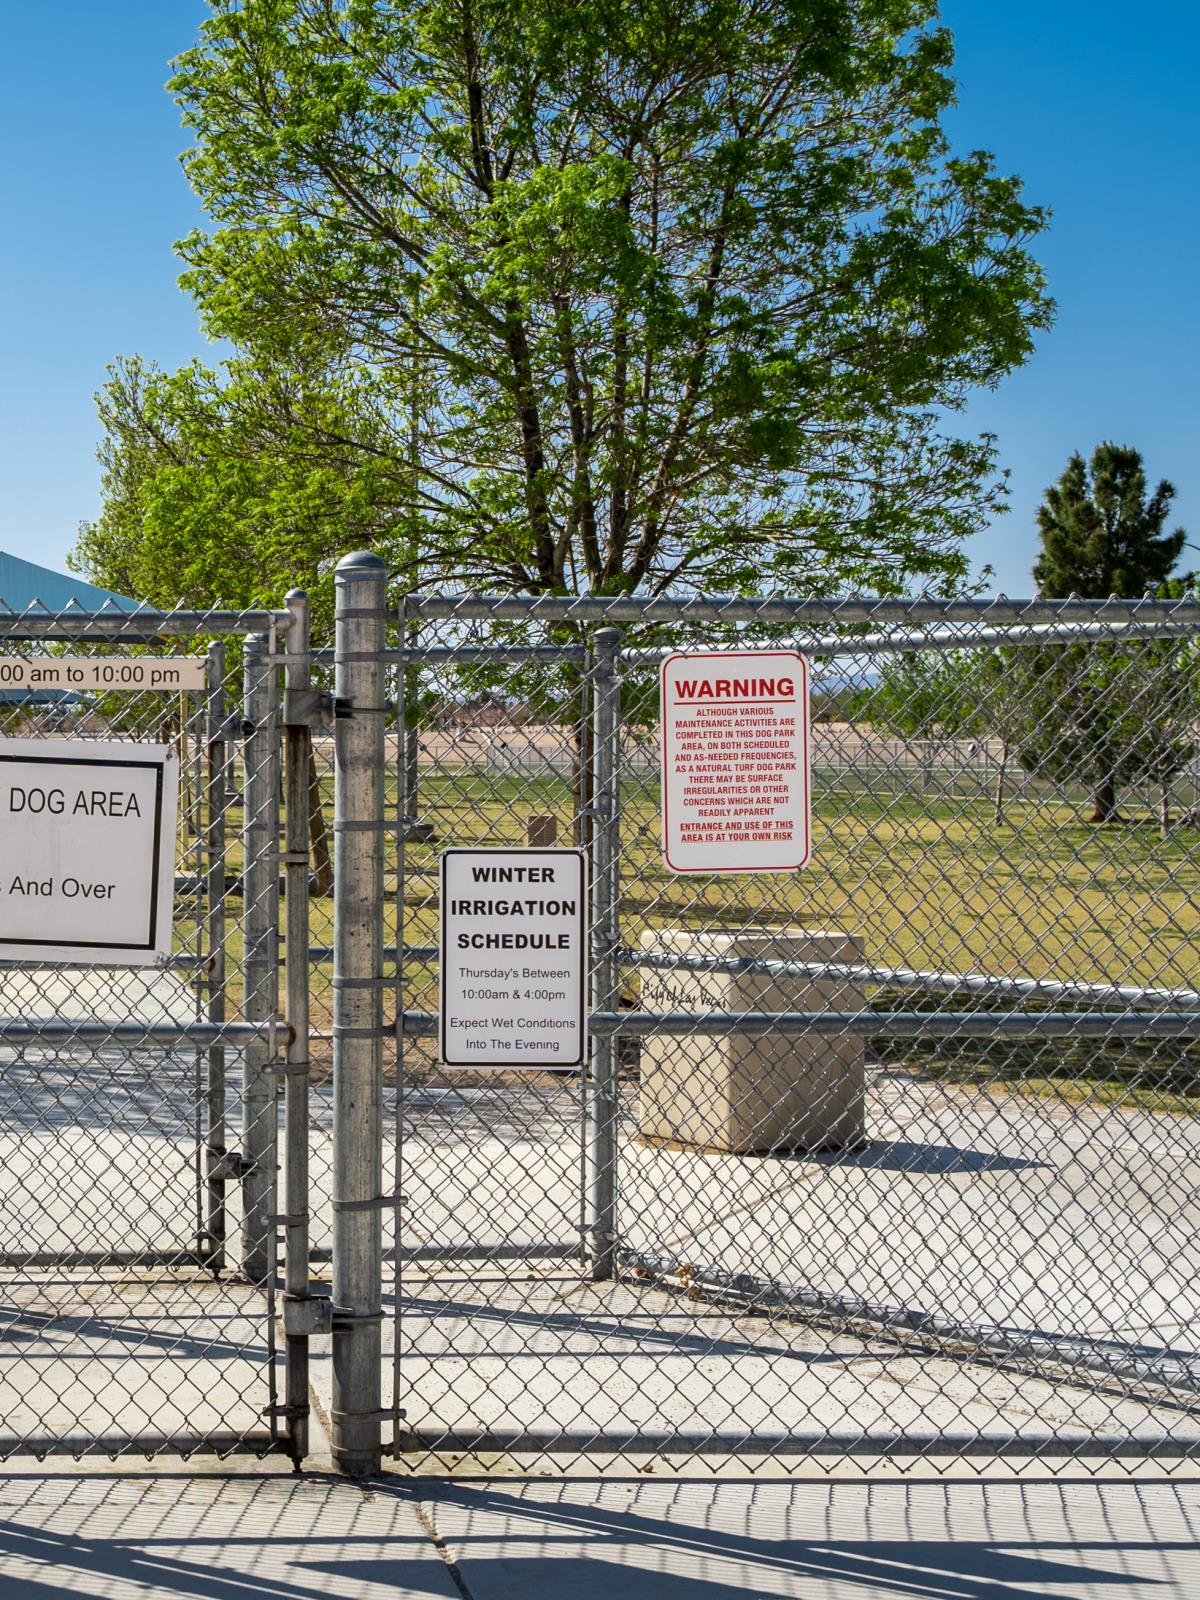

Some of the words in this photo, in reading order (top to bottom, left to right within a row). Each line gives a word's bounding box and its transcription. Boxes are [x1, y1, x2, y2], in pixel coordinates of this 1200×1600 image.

[30, 668, 60, 682] am
[66, 666, 84, 682] to
[92, 665, 143, 682] 10:00
[150, 669, 180, 686] pm
[674, 677, 794, 698] WARNING
[675, 719, 731, 728] MAINTENANCE
[734, 718, 777, 726] ACTIVITIES
[675, 731, 722, 739] COMPLETED
[744, 740, 789, 748] SCHEDULED
[741, 751, 796, 760] FREQUENCIES,
[747, 774, 783, 782] SURFACE
[684, 786, 747, 794] IRREGULARITIES
[9, 787, 64, 814] DOG
[72, 790, 141, 817] AREA
[683, 798, 725, 806] CONCERNS
[680, 822, 722, 831] ENTRANCE
[775, 820, 793, 829] THIS
[681, 834, 702, 842] AREA
[727, 832, 750, 841] YOUR
[752, 832, 771, 840] OWN
[774, 832, 792, 840] RISK
[471, 867, 555, 882] WINTER
[8, 876, 52, 896] And
[61, 878, 115, 899] Over
[451, 900, 575, 916] IRRIGATION
[457, 933, 570, 949] SCHEDULE
[458, 967, 518, 980] Thursday's
[522, 968, 570, 978] Between
[462, 989, 508, 999] 10:00am
[512, 989, 520, 999] &
[523, 989, 565, 1001] 4:00pm
[450, 1017, 488, 1029] Expect
[491, 1018, 513, 1027] Wet
[517, 1018, 575, 1028] Conditions
[466, 1039, 486, 1049] Into
[490, 1039, 511, 1049] The
[515, 1039, 559, 1051] Evening
